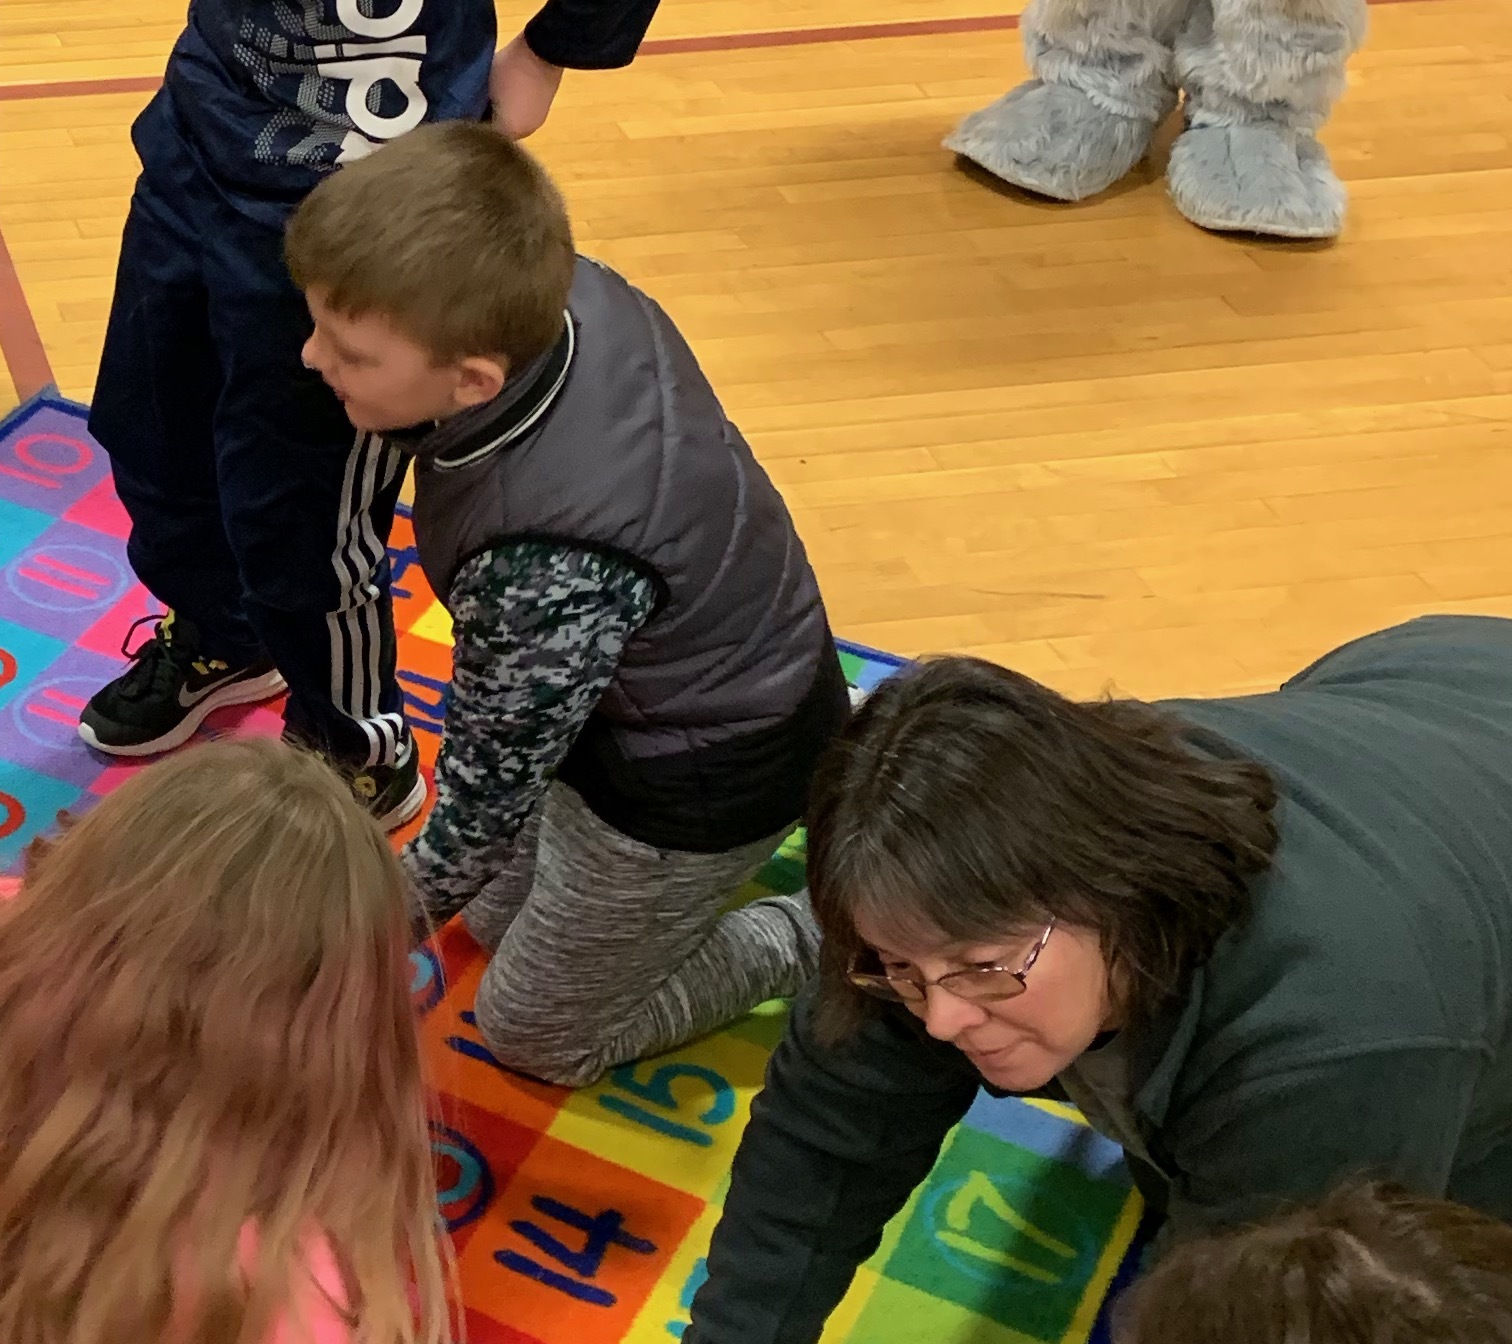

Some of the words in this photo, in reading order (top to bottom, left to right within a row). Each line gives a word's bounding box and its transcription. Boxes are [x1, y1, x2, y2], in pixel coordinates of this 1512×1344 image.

[18, 555, 111, 600] 11
[597, 1061, 737, 1149] 15
[495, 1195, 658, 1308] 14
